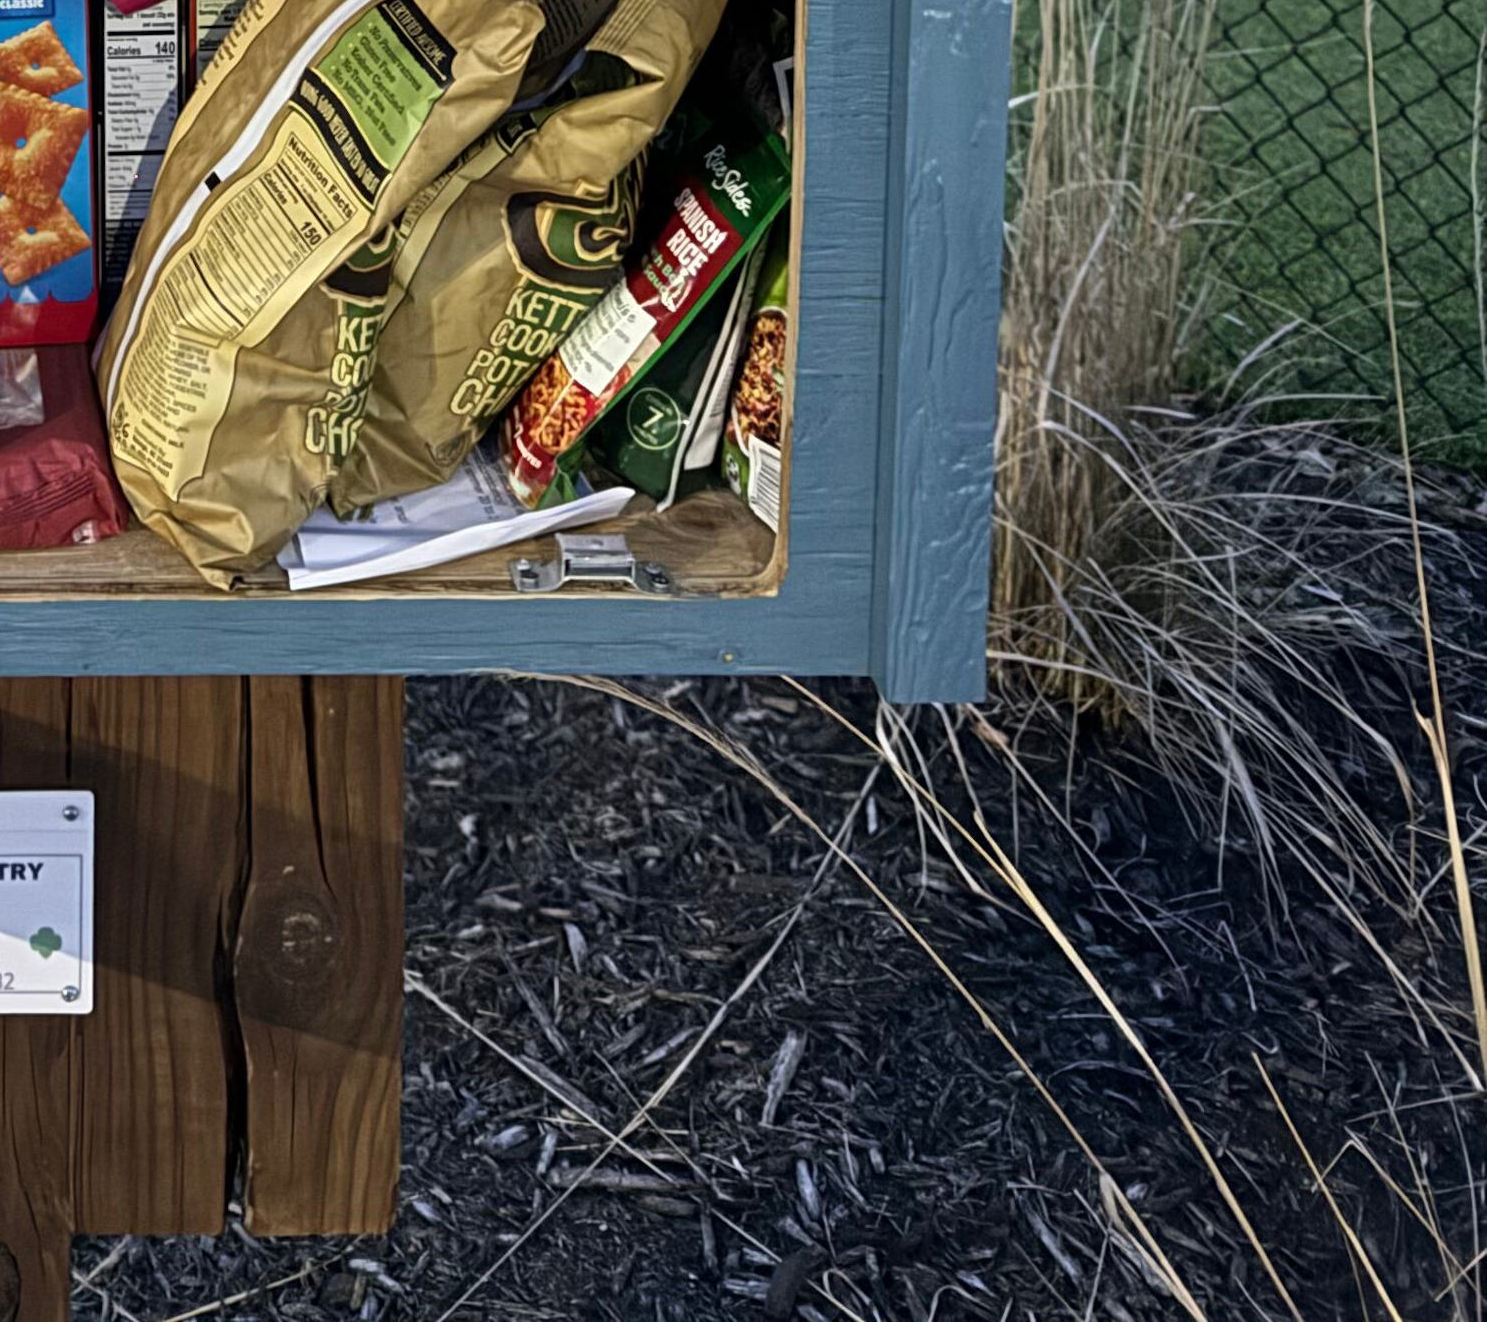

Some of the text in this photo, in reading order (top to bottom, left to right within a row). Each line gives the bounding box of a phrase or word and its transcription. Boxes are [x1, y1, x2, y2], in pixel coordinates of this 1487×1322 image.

[389, 0, 423, 41] CERTIFIED
[107, 46, 141, 56] Calories
[155, 41, 175, 55] 140
[263, 171, 288, 206] Calories
[287, 136, 356, 219] Nutrition Facts
[712, 167, 752, 218] Sides
[299, 219, 323, 248] 150
[673, 187, 728, 254] SPANISH
[665, 226, 709, 279] RICE
